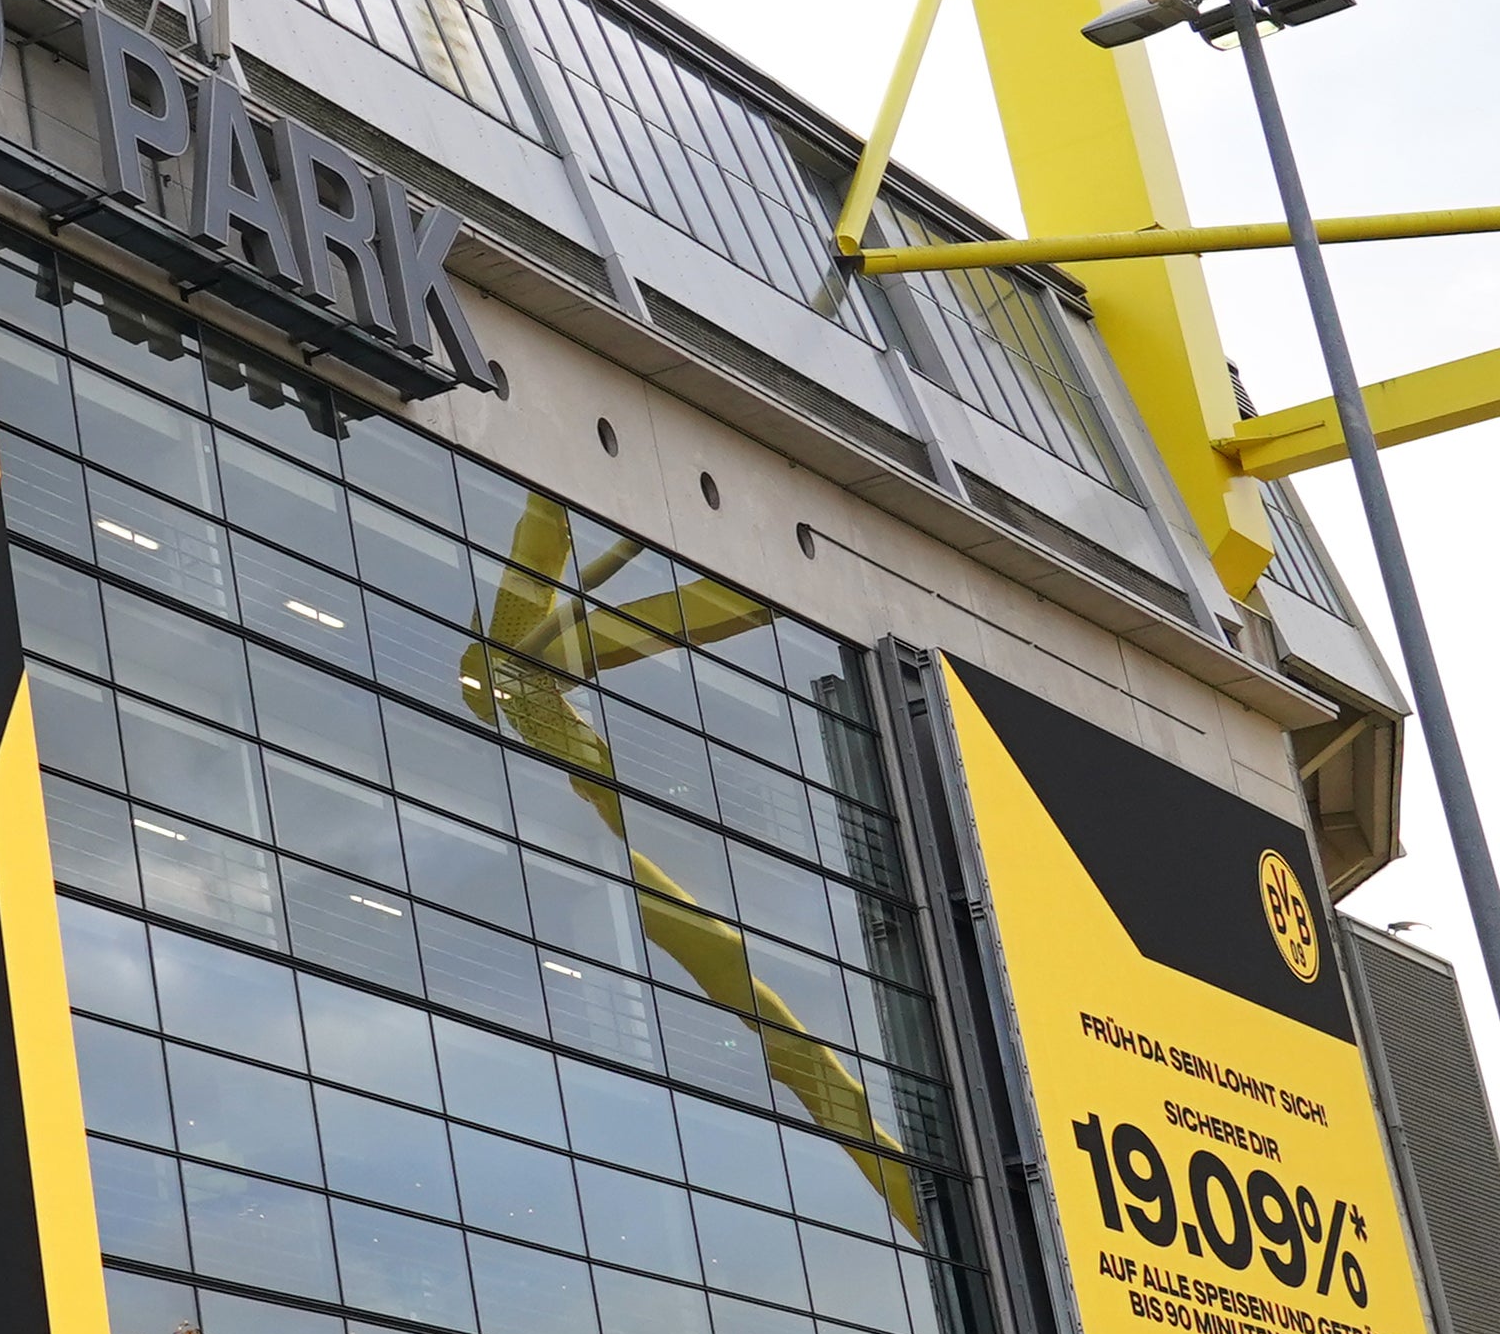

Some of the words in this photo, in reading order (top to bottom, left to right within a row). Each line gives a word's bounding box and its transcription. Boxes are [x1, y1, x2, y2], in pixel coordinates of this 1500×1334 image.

[82, 7, 498, 392] PARK
[1266, 863, 1311, 946] BVB
[1080, 1011, 1137, 1055] FRÜH
[1137, 1033, 1169, 1066] DA
[1169, 1046, 1215, 1084] SEIN
[1214, 1063, 1276, 1107] LOHNT
[1279, 1089, 1329, 1128] SICH!
[1164, 1100, 1249, 1151] SICHERE
[1248, 1130, 1282, 1163] DIR
[1099, 1250, 1138, 1284] AUF
[1142, 1264, 1192, 1301] ALLE
[1192, 1278, 1277, 1327] SPEISEN
[1128, 1289, 1164, 1323] BIS
[1165, 1303, 1193, 1331] 90
